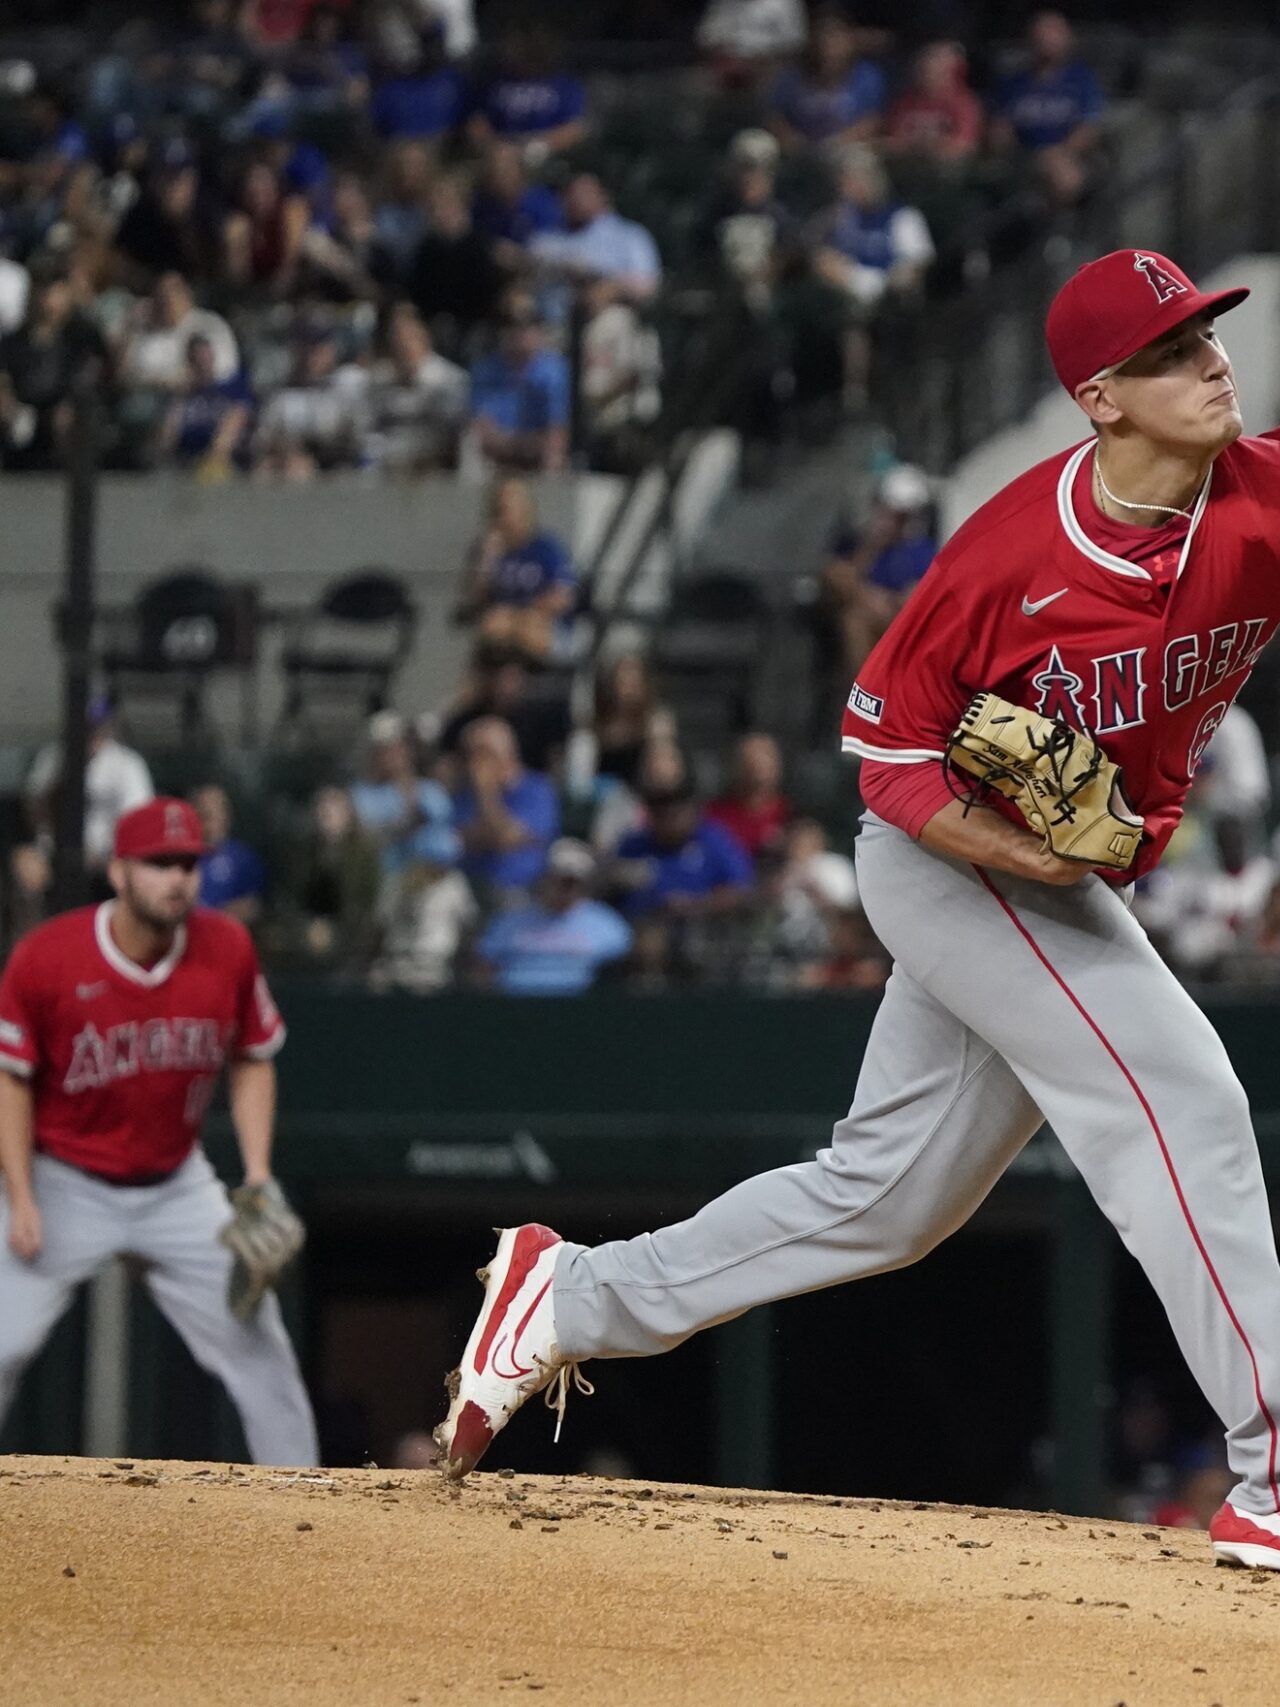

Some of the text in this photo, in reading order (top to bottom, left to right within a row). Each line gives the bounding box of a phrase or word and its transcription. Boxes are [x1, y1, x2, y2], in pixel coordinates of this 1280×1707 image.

[1134, 252, 1188, 304] A
[1032, 618, 1268, 739] ANGEL
[983, 743, 1008, 761] Sam
